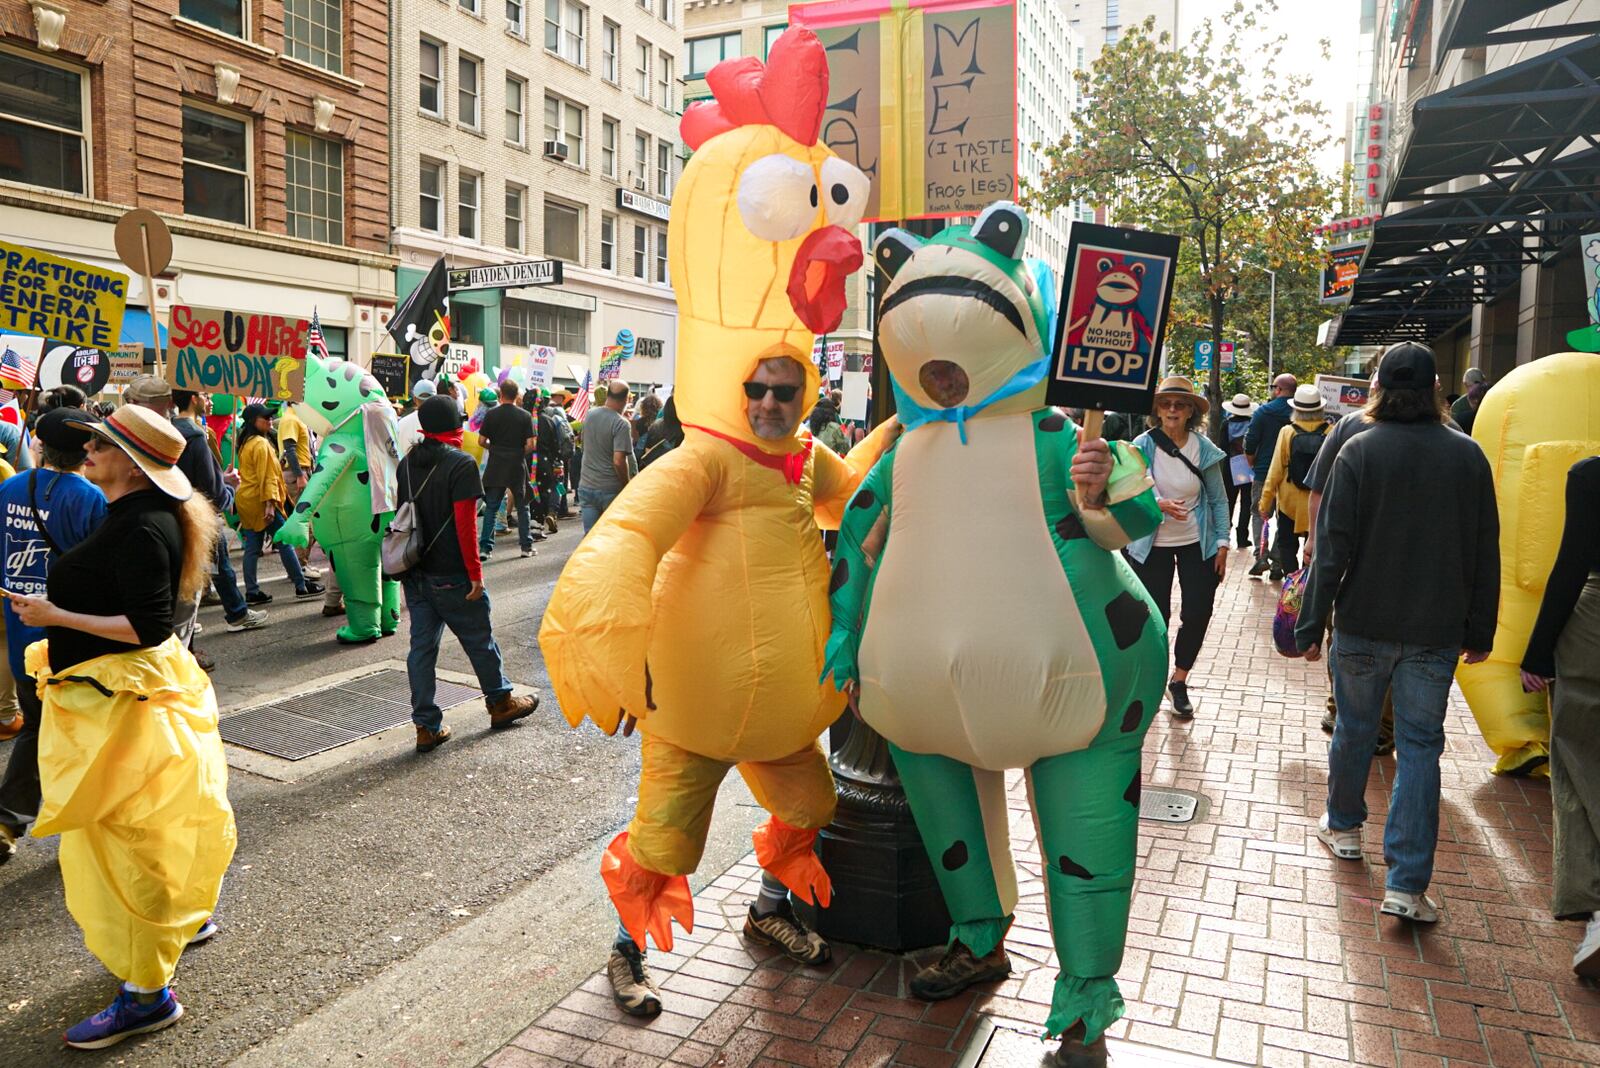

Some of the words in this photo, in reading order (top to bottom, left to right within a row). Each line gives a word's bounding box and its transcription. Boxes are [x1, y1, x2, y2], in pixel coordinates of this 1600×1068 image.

[954, 138, 1013, 157] TASTE
[1367, 105, 1381, 197] REGAL
[952, 157, 993, 173] LIKE
[927, 181, 966, 200] FROG
[971, 173, 1014, 198] LEGS)
[471, 267, 510, 284] HAYDEN
[513, 262, 553, 280] DENTAL
[3, 270, 46, 291] FOR
[58, 284, 97, 305] OUR
[0, 284, 109, 325] ENERAL
[0, 304, 111, 347] TRIKE
[171, 305, 222, 350] See
[223, 310, 245, 352] U
[246, 314, 309, 359] HERE
[1088, 327, 1103, 336] NO
[1105, 329, 1133, 339] HOPE
[634, 337, 665, 359] AT&T
[1086, 335, 1133, 347] WITHOUT
[1071, 347, 1144, 376] HOP
[1201, 355, 1209, 366] 2
[7, 503, 50, 521] UNIN
[6, 539, 51, 576] aft
